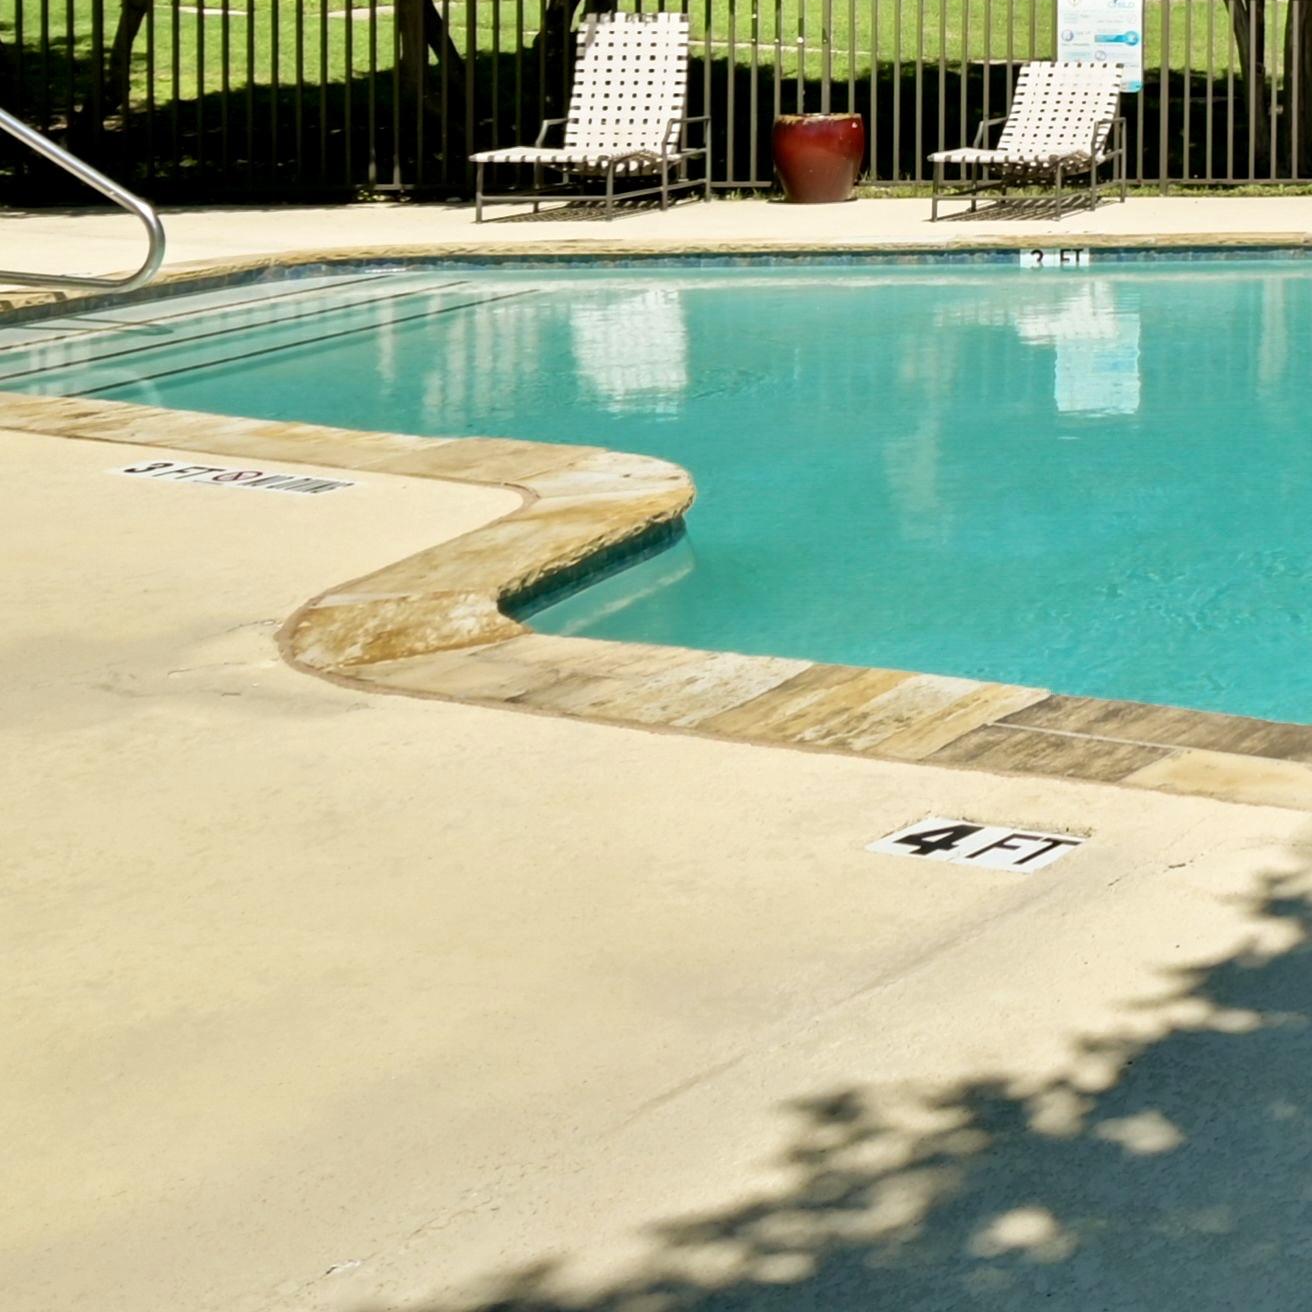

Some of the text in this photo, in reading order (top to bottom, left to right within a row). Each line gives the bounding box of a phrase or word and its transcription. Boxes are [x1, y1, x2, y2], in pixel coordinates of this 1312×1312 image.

[1060, 248, 1084, 263] FT
[123, 462, 226, 479] 3 FT
[892, 824, 1082, 865] 4 FT
